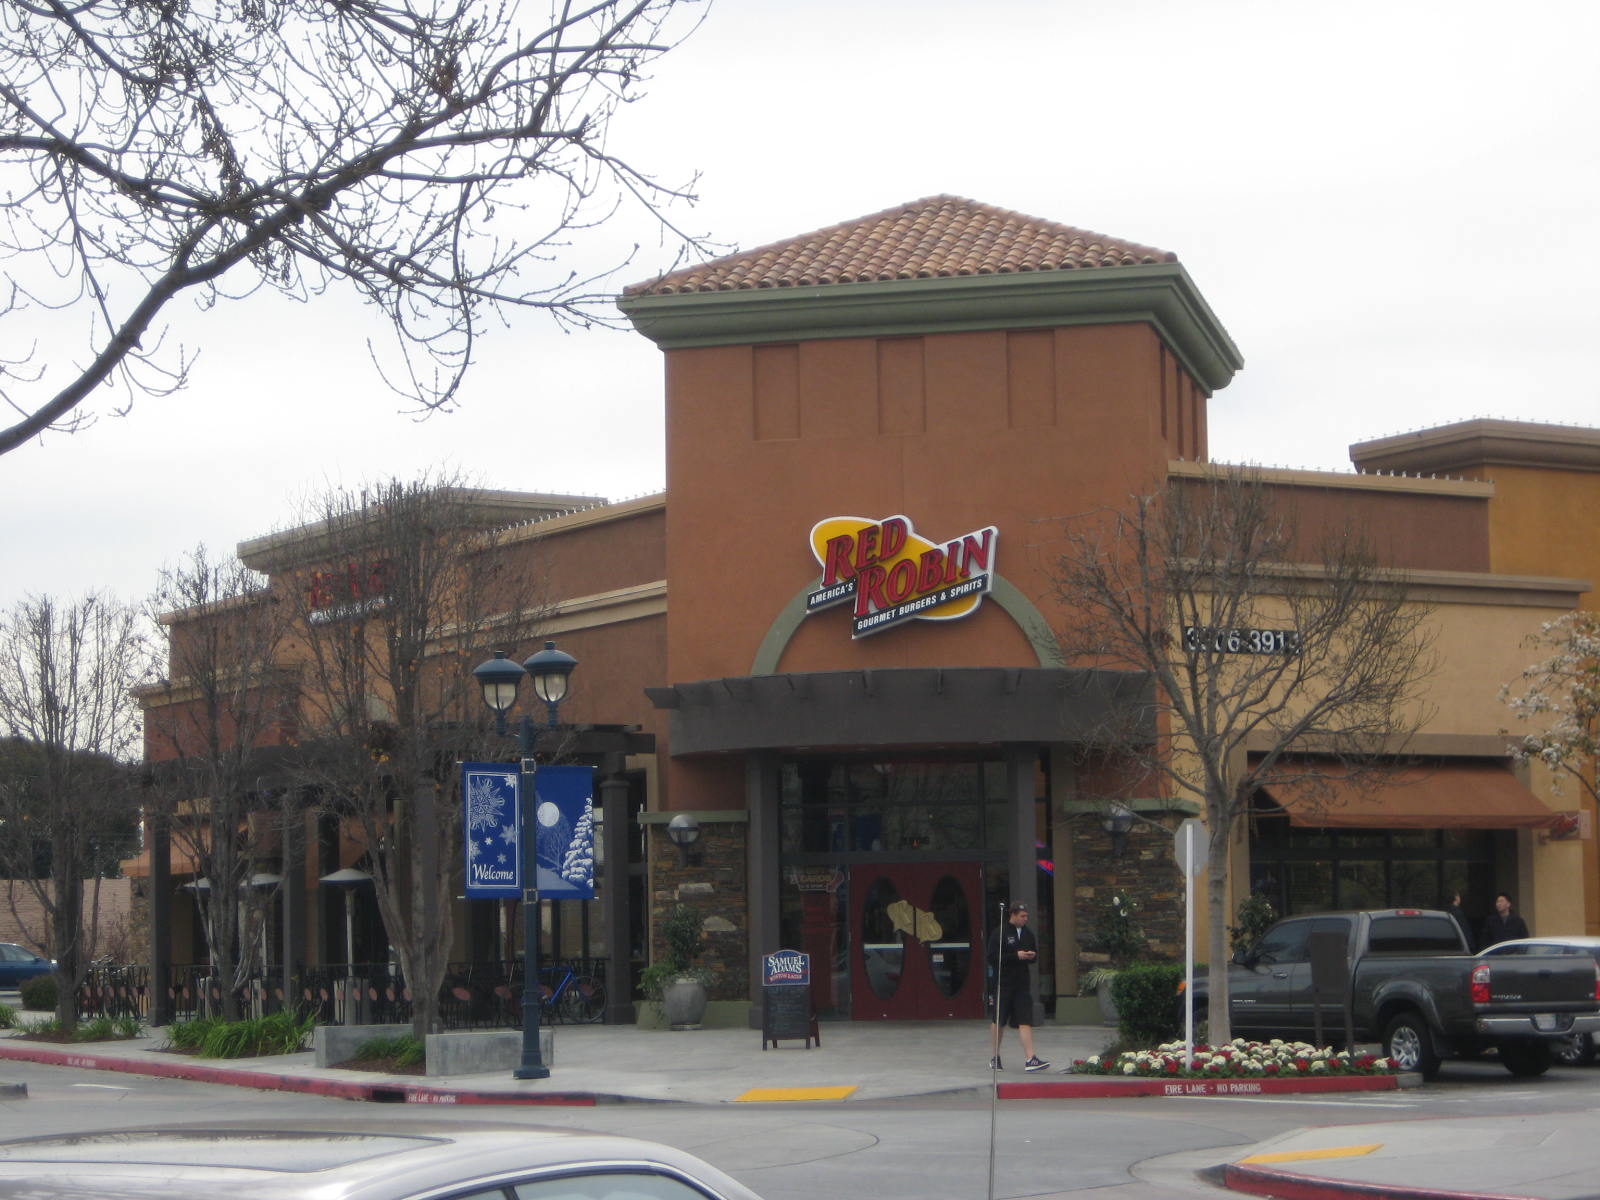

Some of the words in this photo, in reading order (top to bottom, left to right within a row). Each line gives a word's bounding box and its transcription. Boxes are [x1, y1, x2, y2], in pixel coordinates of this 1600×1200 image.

[822, 517, 907, 587] RED
[854, 529, 993, 617] ROBIN
[810, 580, 854, 605] AMERICA'S
[857, 609, 896, 631] GOURMET
[899, 595, 937, 616] BURGERS
[940, 591, 947, 601] &
[950, 579, 983, 597] SPIRITS
[472, 863, 514, 880] Welcome
[768, 955, 805, 967] SAMUEL
[770, 964, 802, 975] ADAMS
[1165, 1084, 1183, 1094] FIRE
[1186, 1084, 1207, 1093] LANE
[1217, 1083, 1228, 1093] NO
[1230, 1083, 1261, 1093] PARKING
